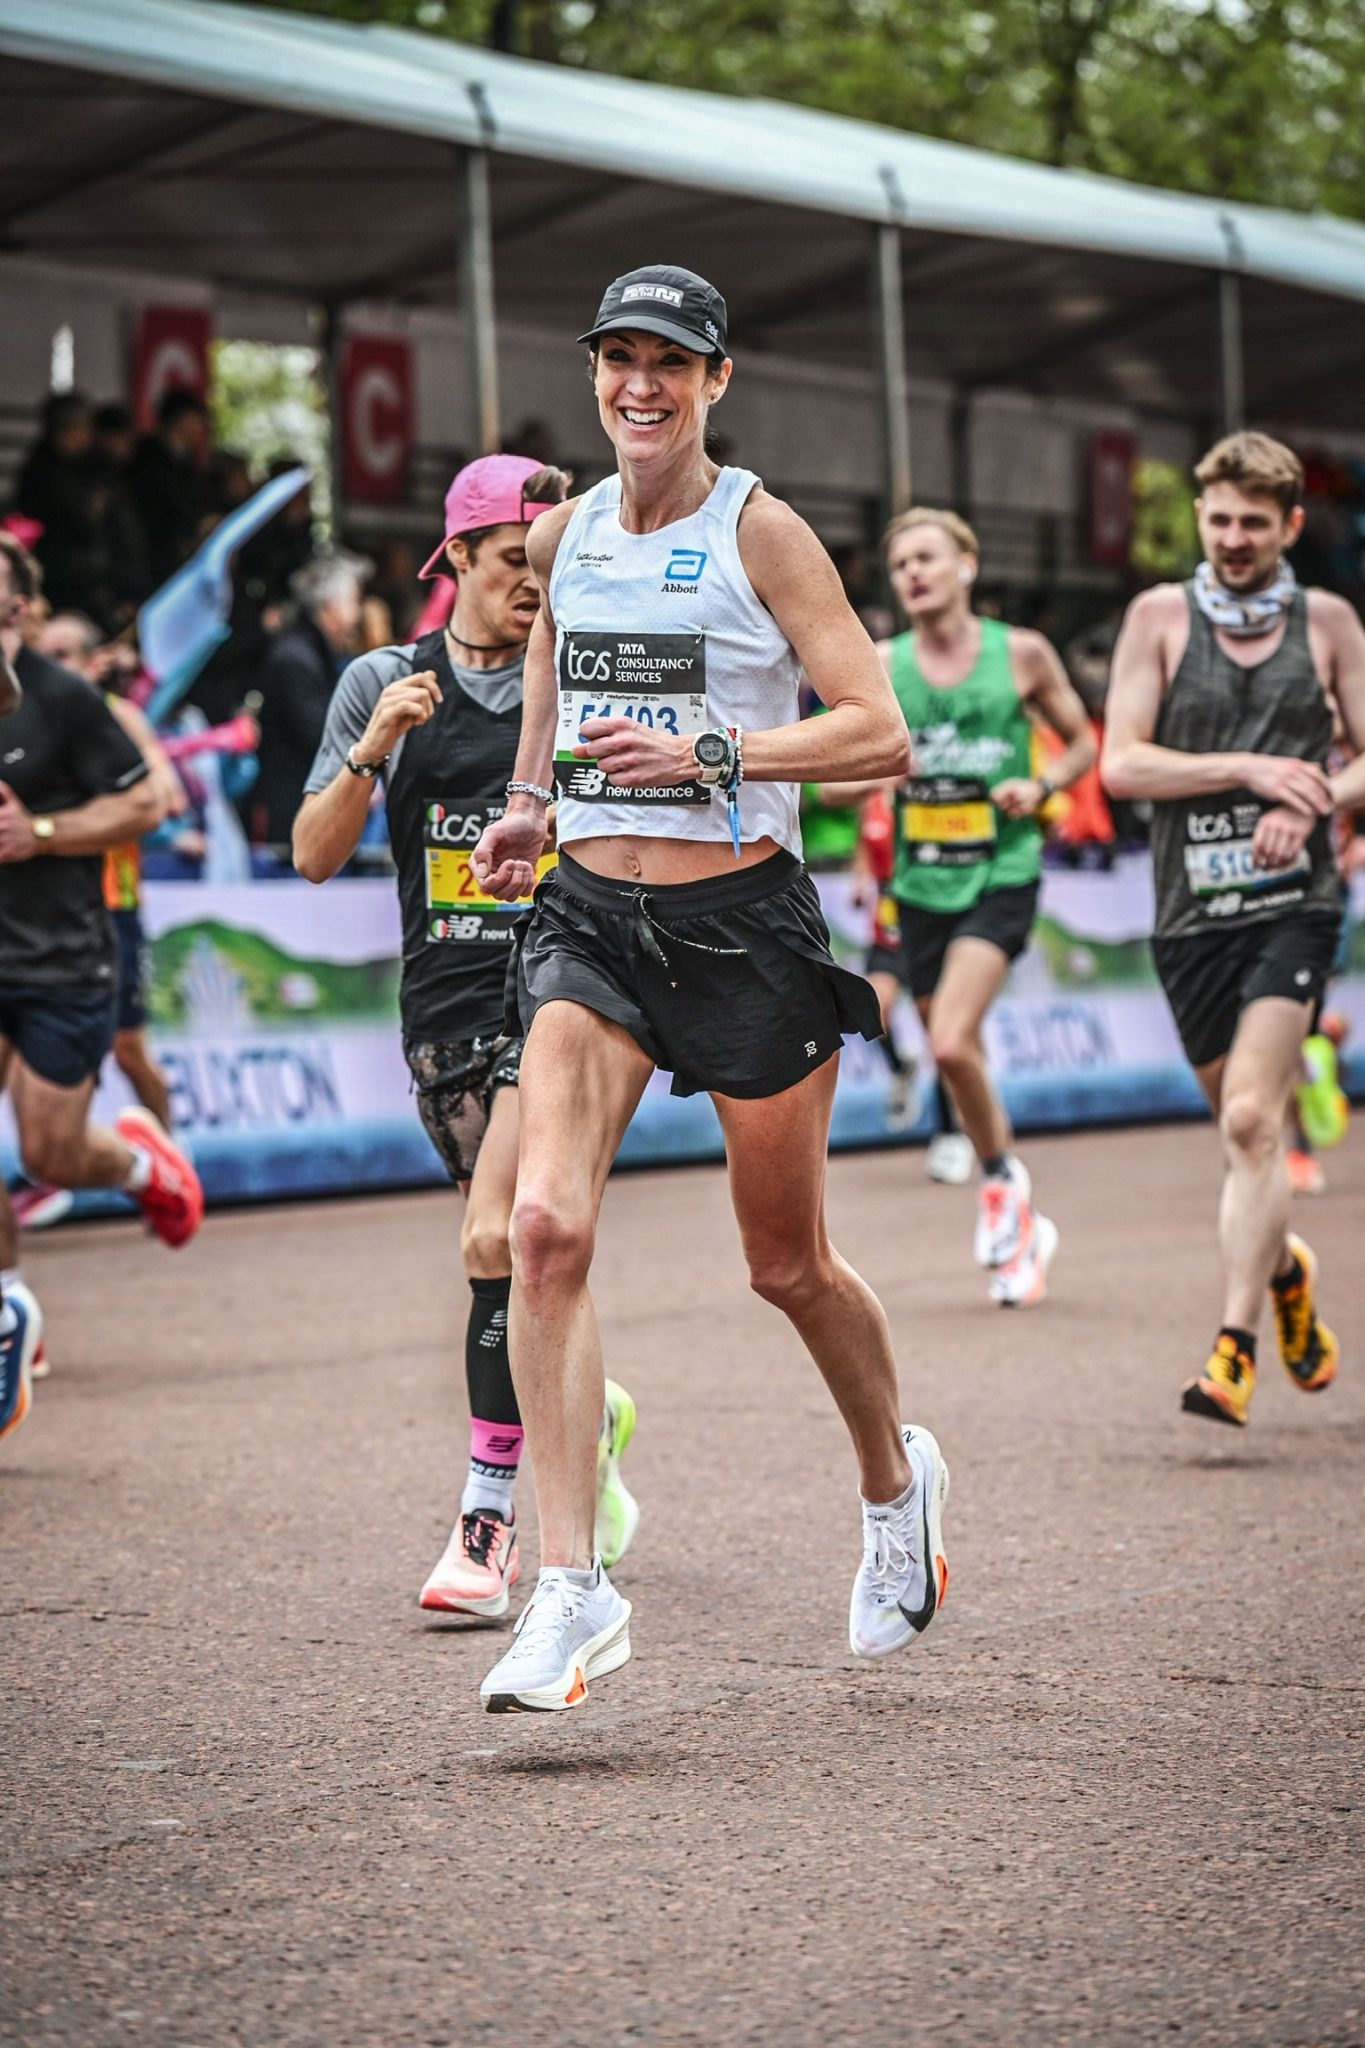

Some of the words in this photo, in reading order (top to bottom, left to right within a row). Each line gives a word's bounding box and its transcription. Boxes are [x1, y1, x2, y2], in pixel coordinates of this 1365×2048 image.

[351, 367, 400, 475] C
[661, 583, 699, 594] Abbott
[617, 643, 647, 655] TATA
[567, 641, 612, 681] tcs
[616, 657, 694, 670] CONSULTANCY
[615, 671, 662, 684] SERVICES
[606, 786, 632, 798] new
